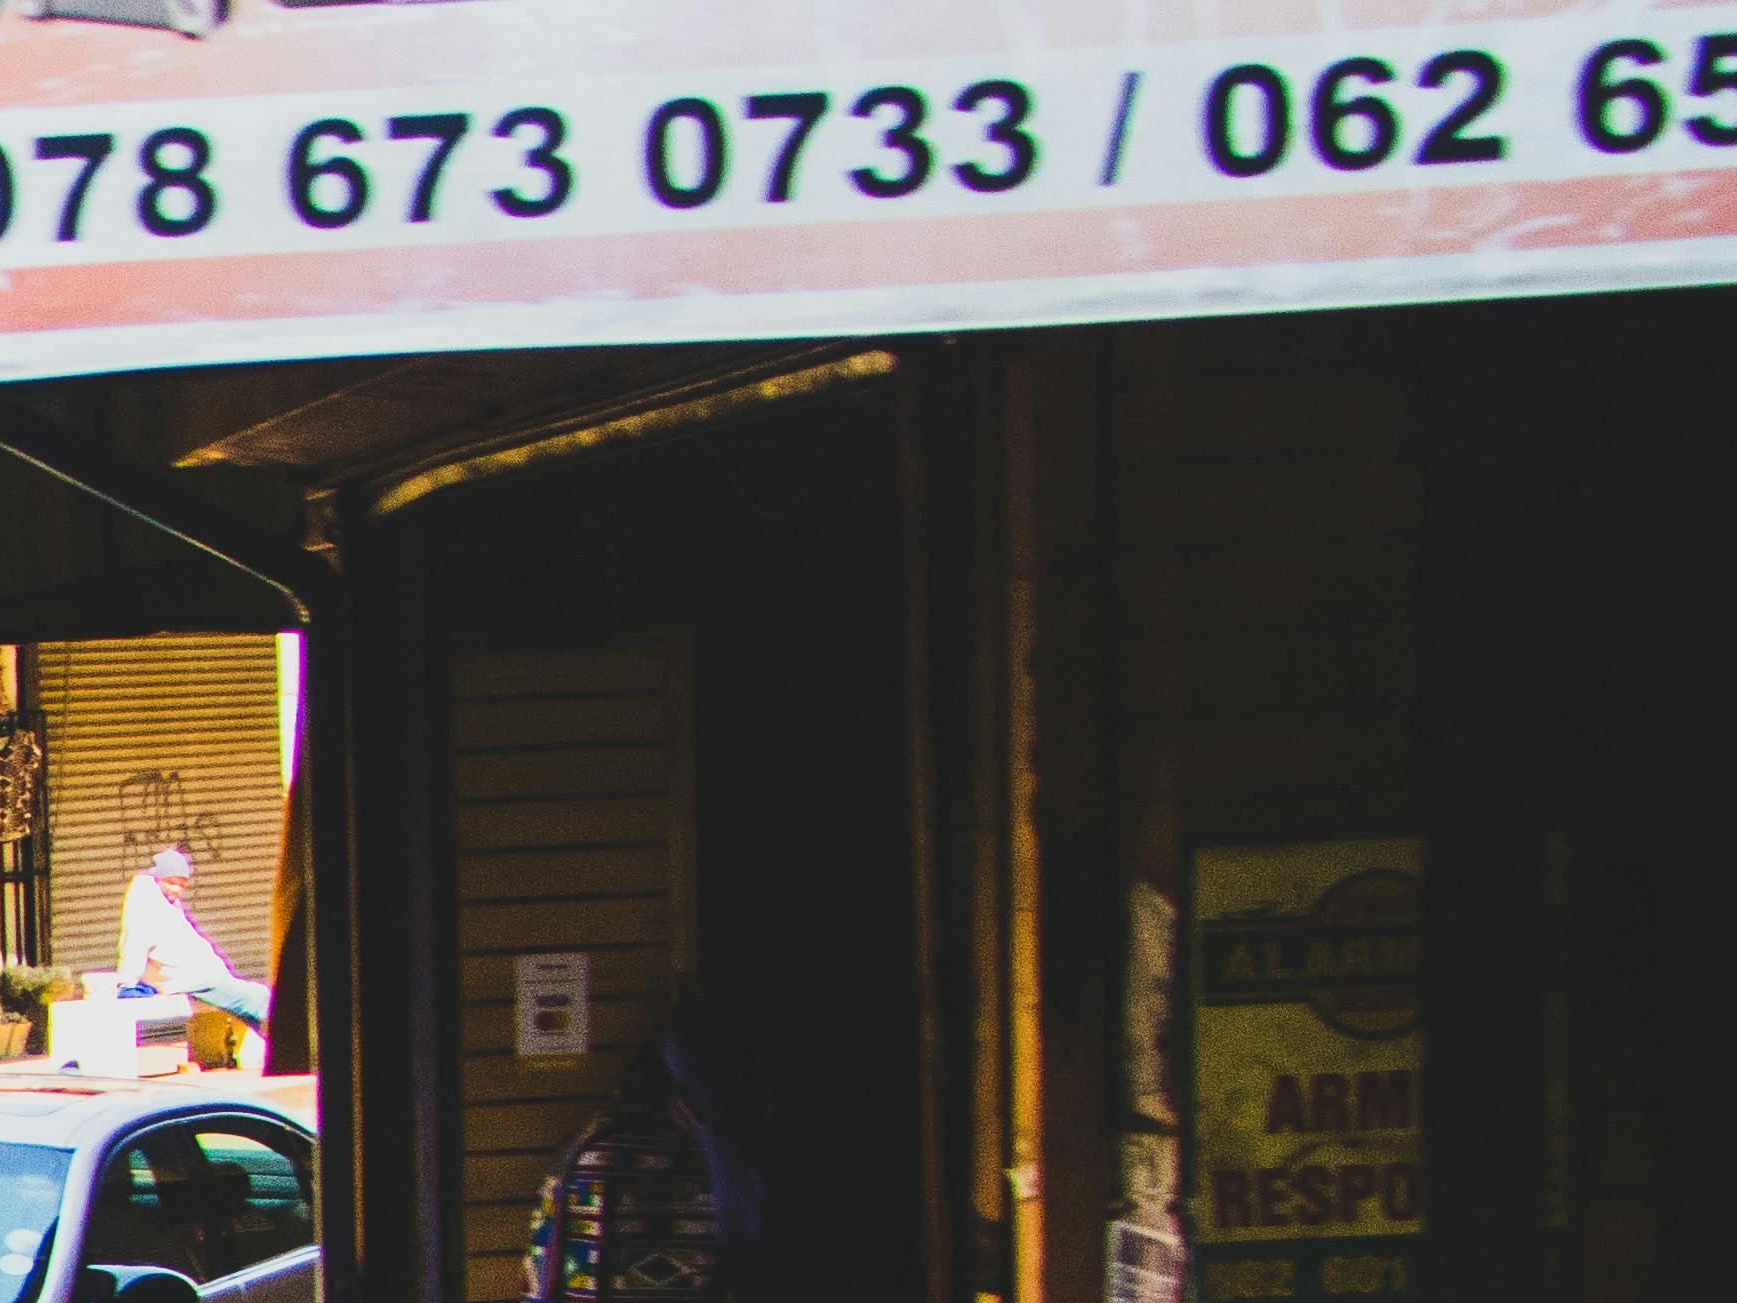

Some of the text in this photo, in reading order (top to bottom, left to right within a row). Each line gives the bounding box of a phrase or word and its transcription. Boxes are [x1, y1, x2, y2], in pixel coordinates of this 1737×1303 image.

[289, 101, 575, 224] 673
[641, 75, 1040, 213] 0733
[1098, 70, 1142, 187] /
[1201, 48, 1512, 178] 062
